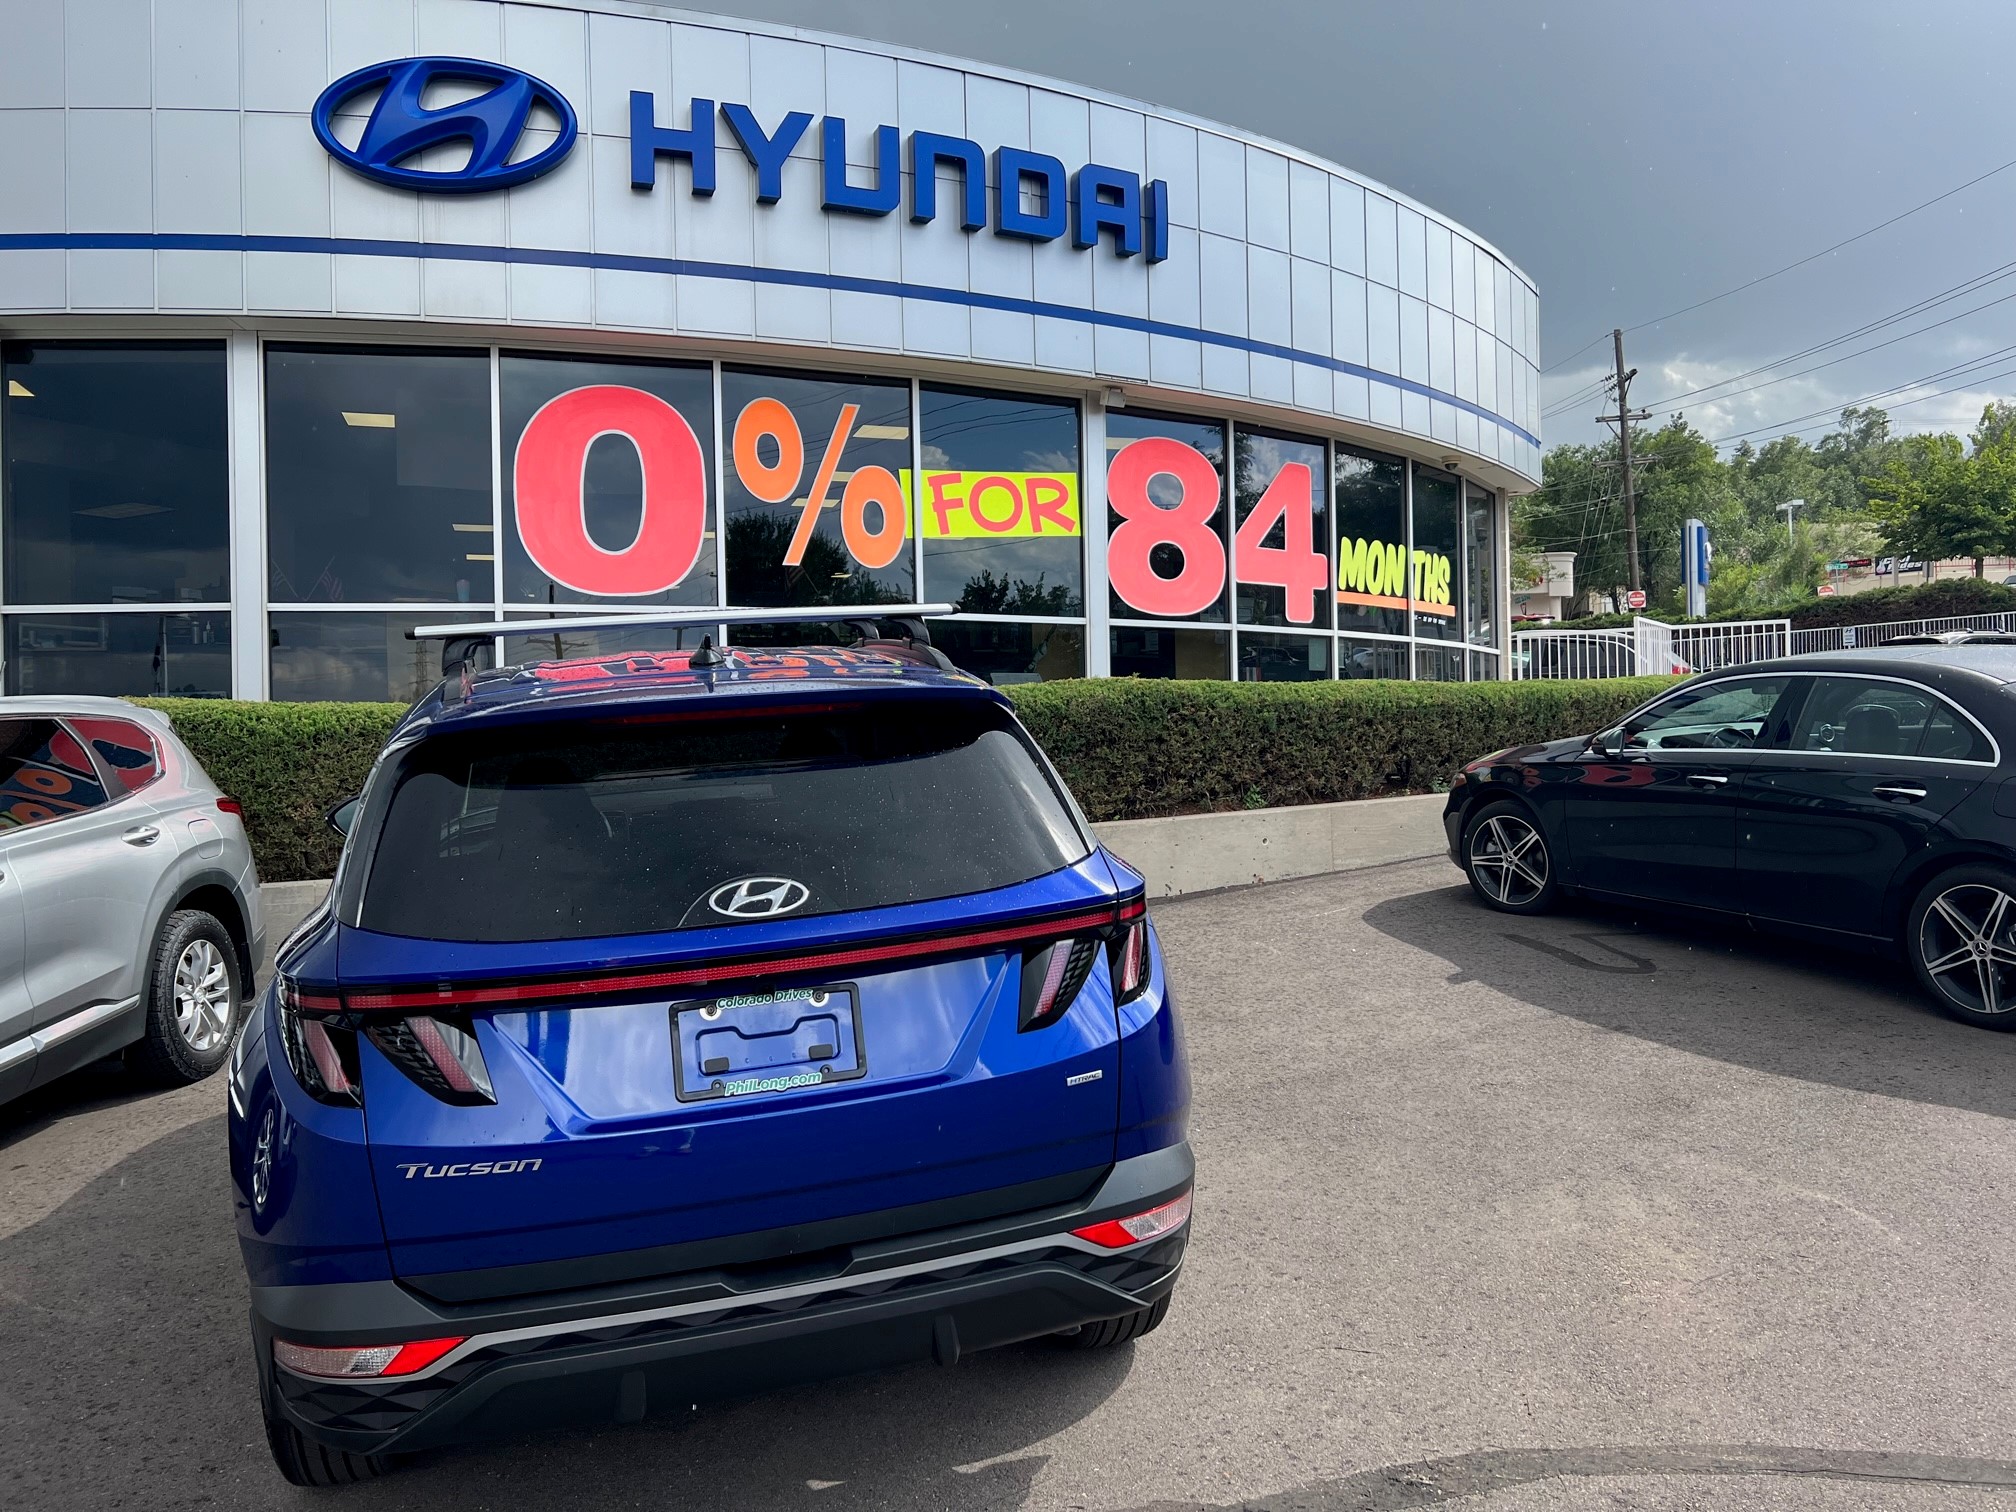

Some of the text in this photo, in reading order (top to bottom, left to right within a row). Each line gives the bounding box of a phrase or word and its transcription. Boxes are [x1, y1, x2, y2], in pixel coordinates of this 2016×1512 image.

[629, 90, 1169, 264] HYUNDAI
[928, 472, 1076, 535] FOR
[1106, 436, 1328, 623] 84
[1338, 536, 1451, 606] MONTHS
[716, 988, 814, 1010] Colorado Drives
[724, 1071, 822, 1096] PhilLong.com
